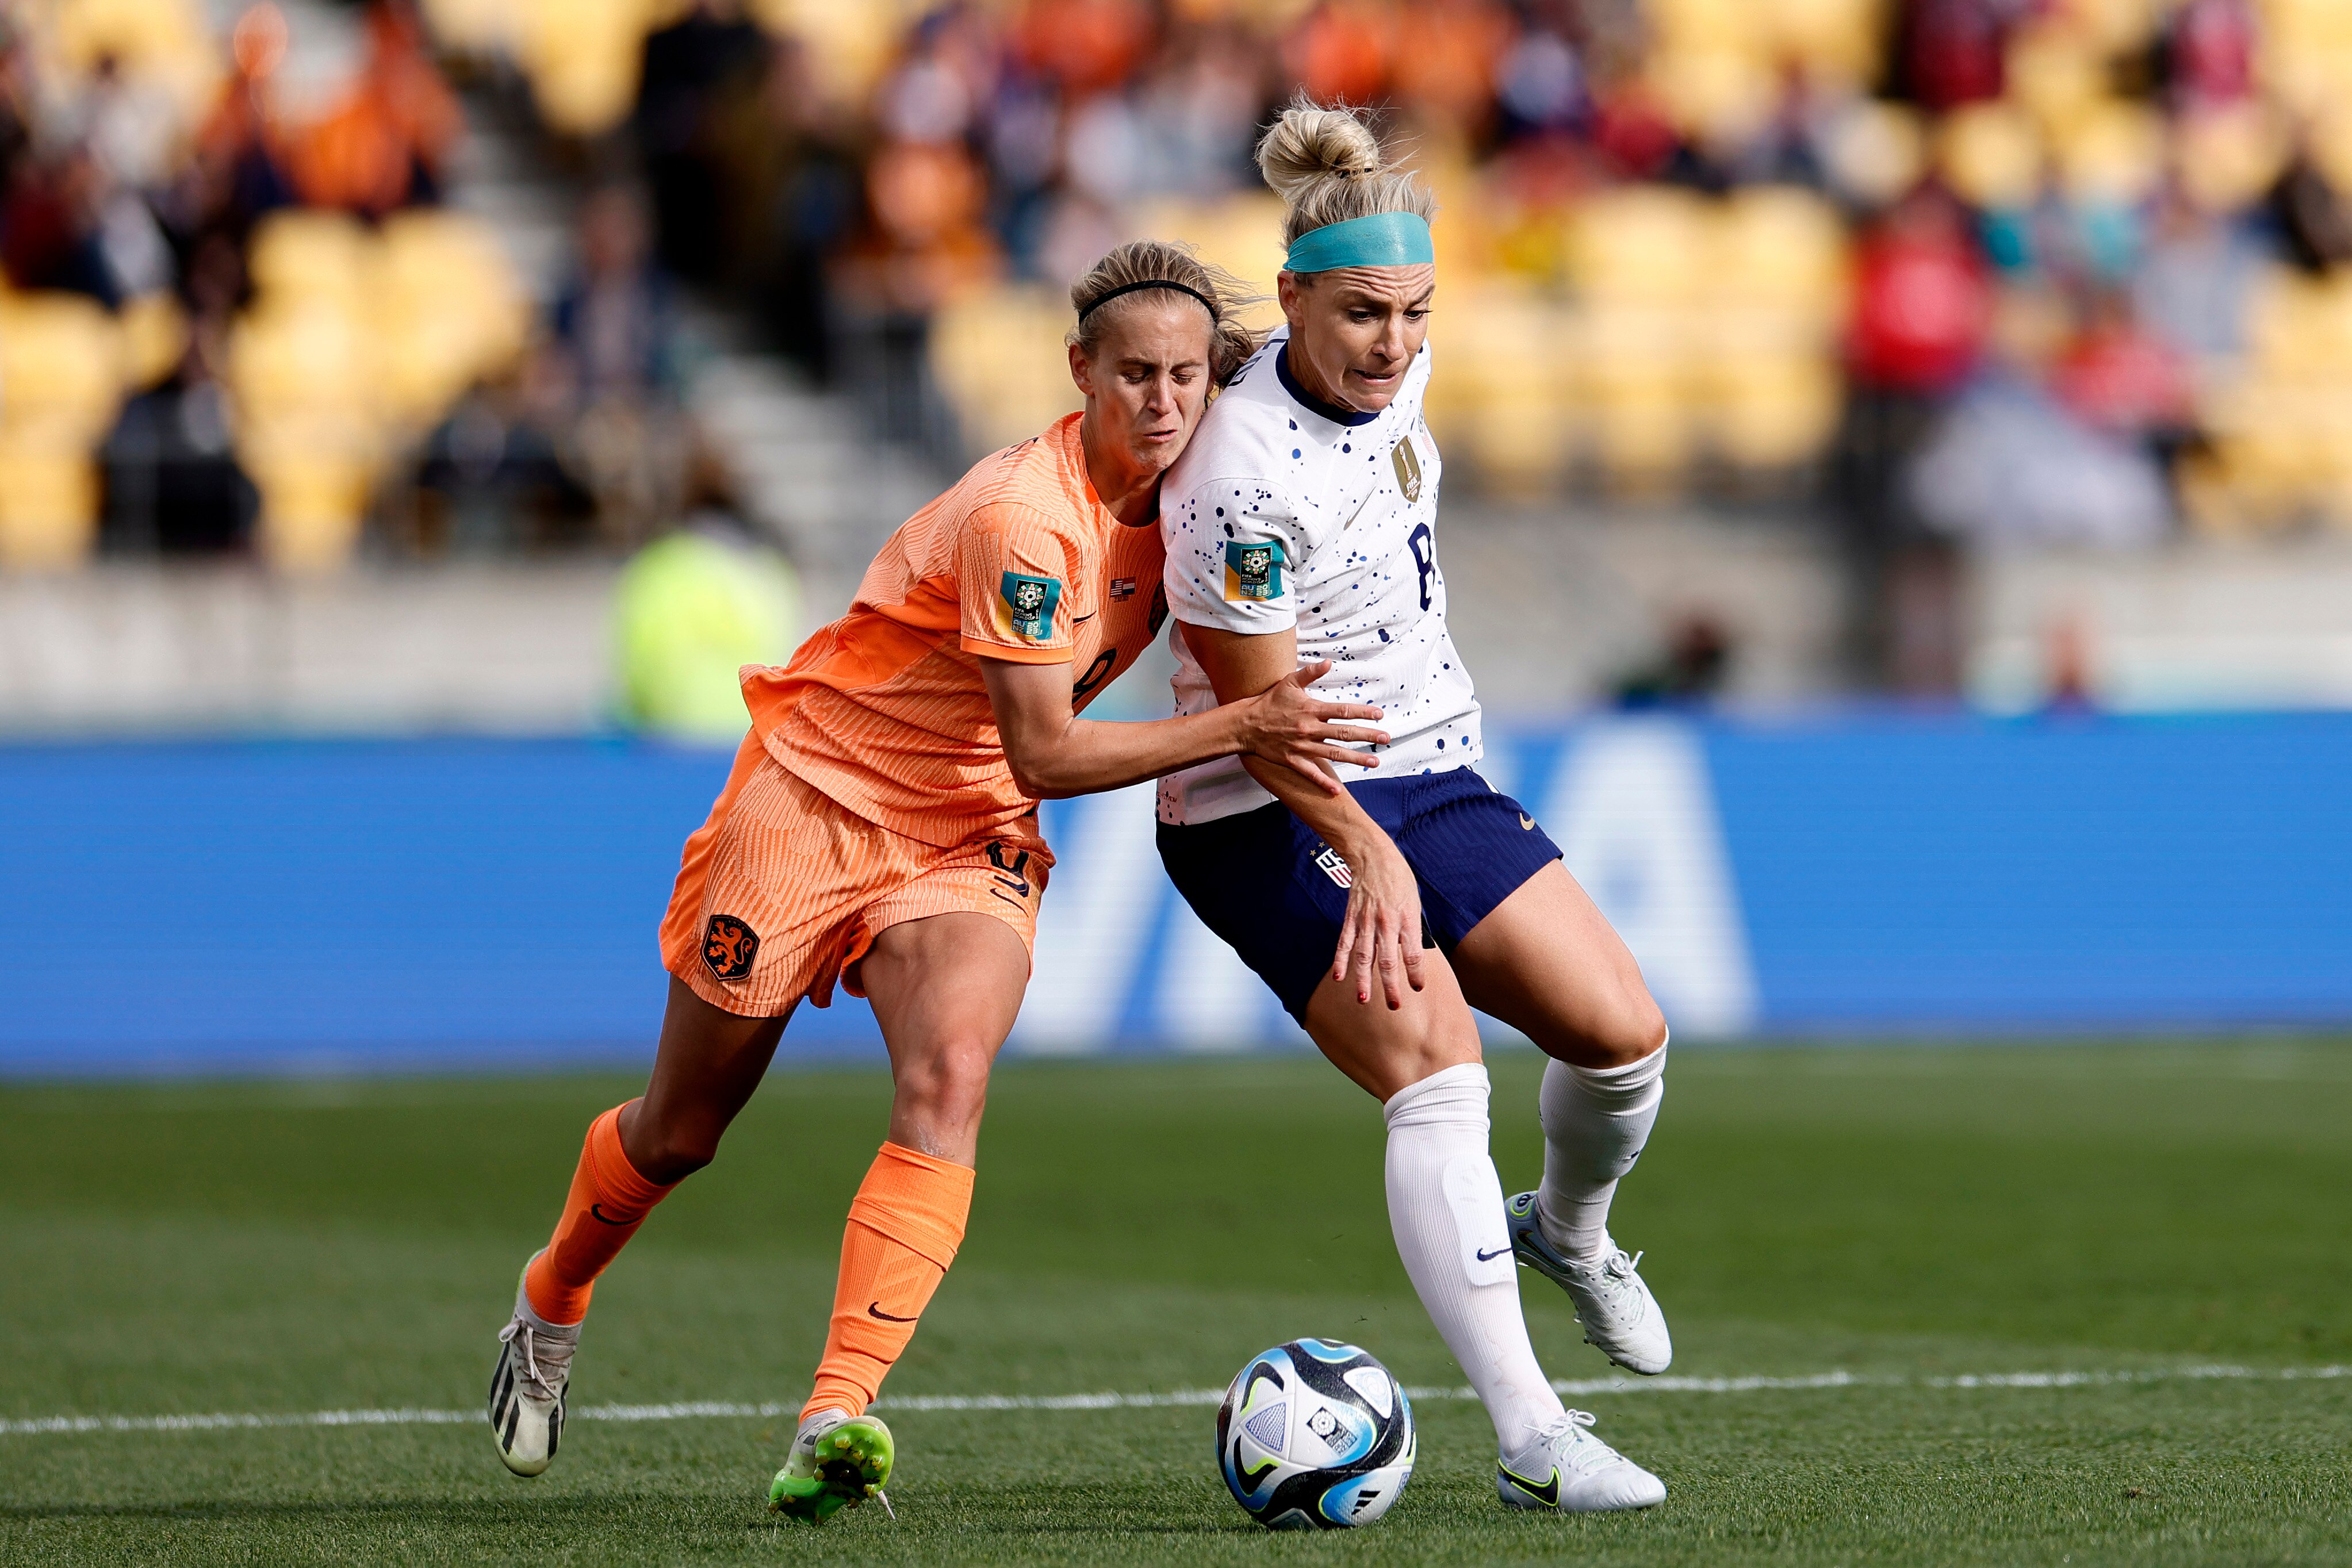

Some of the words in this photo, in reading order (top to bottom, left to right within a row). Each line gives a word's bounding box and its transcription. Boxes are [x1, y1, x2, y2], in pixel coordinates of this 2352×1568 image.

[1406, 476, 1418, 492] FIFA
[1408, 523, 1435, 612] 8
[986, 841, 1029, 898] 9
[999, 719, 1763, 1046] VA
